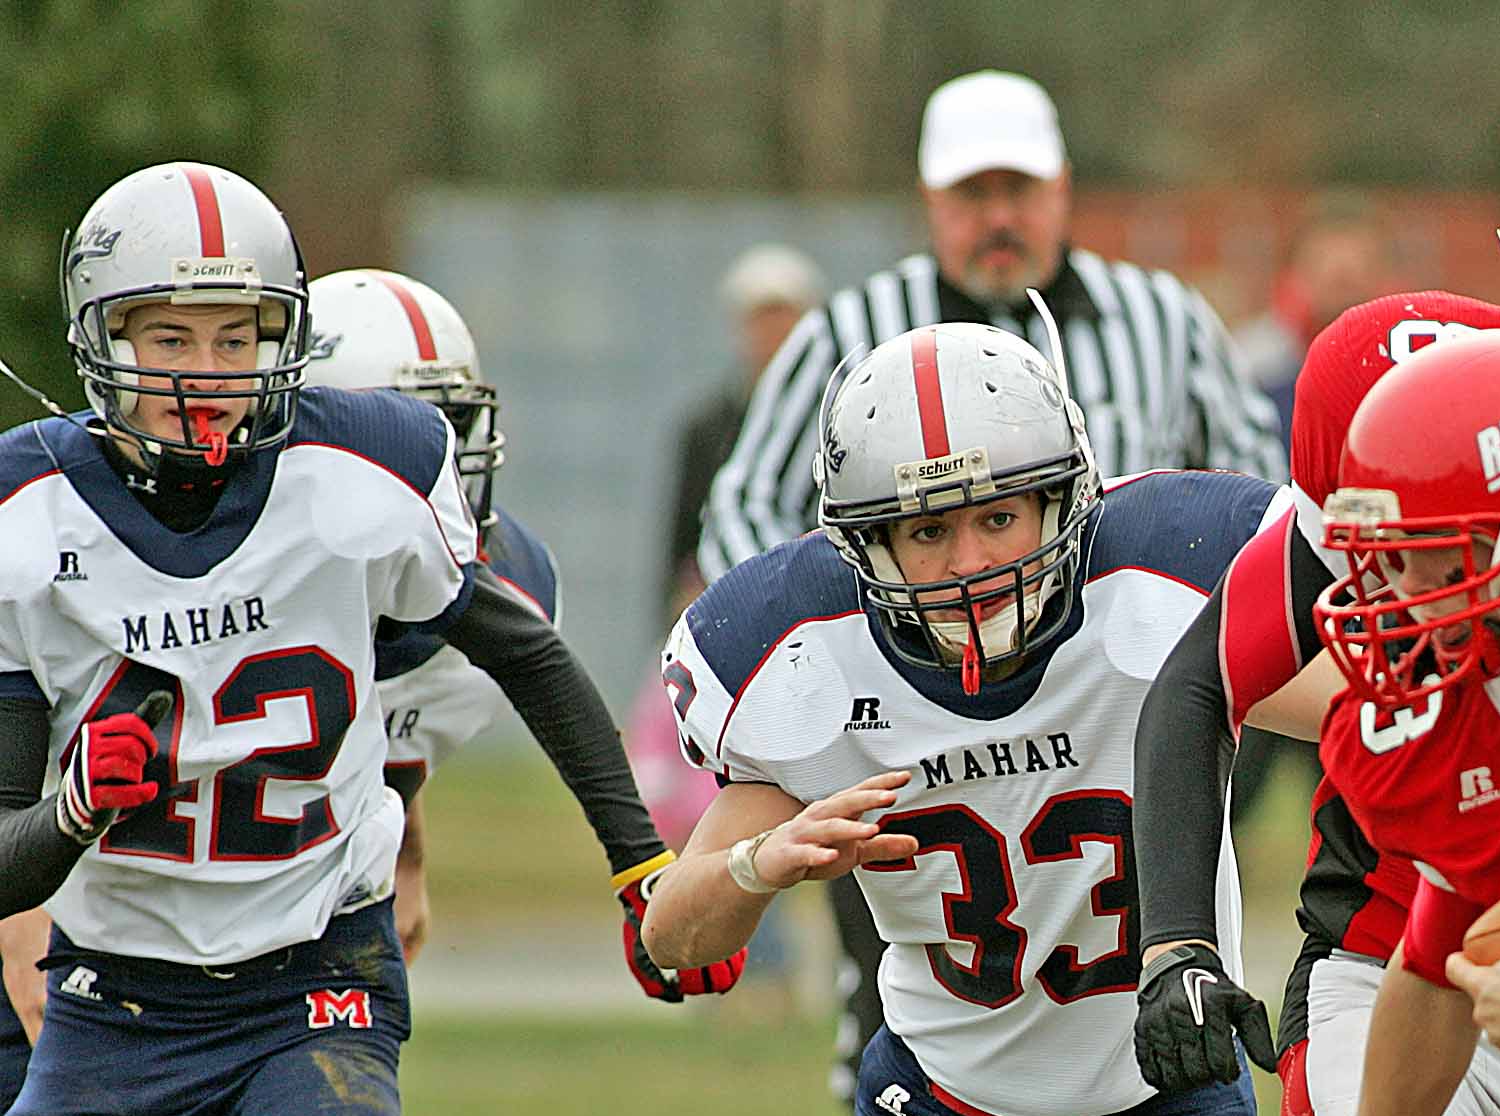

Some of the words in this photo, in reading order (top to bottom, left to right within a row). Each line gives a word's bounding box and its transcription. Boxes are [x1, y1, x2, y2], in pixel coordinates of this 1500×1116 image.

[918, 456, 965, 478] schutt
[121, 596, 270, 654] MAHAR
[843, 719, 892, 732] RUSSELL
[850, 697, 881, 722] R
[60, 644, 357, 863] 42
[919, 731, 1080, 790] MAHAR
[862, 788, 1141, 1010] 33
[306, 988, 373, 1030] M
